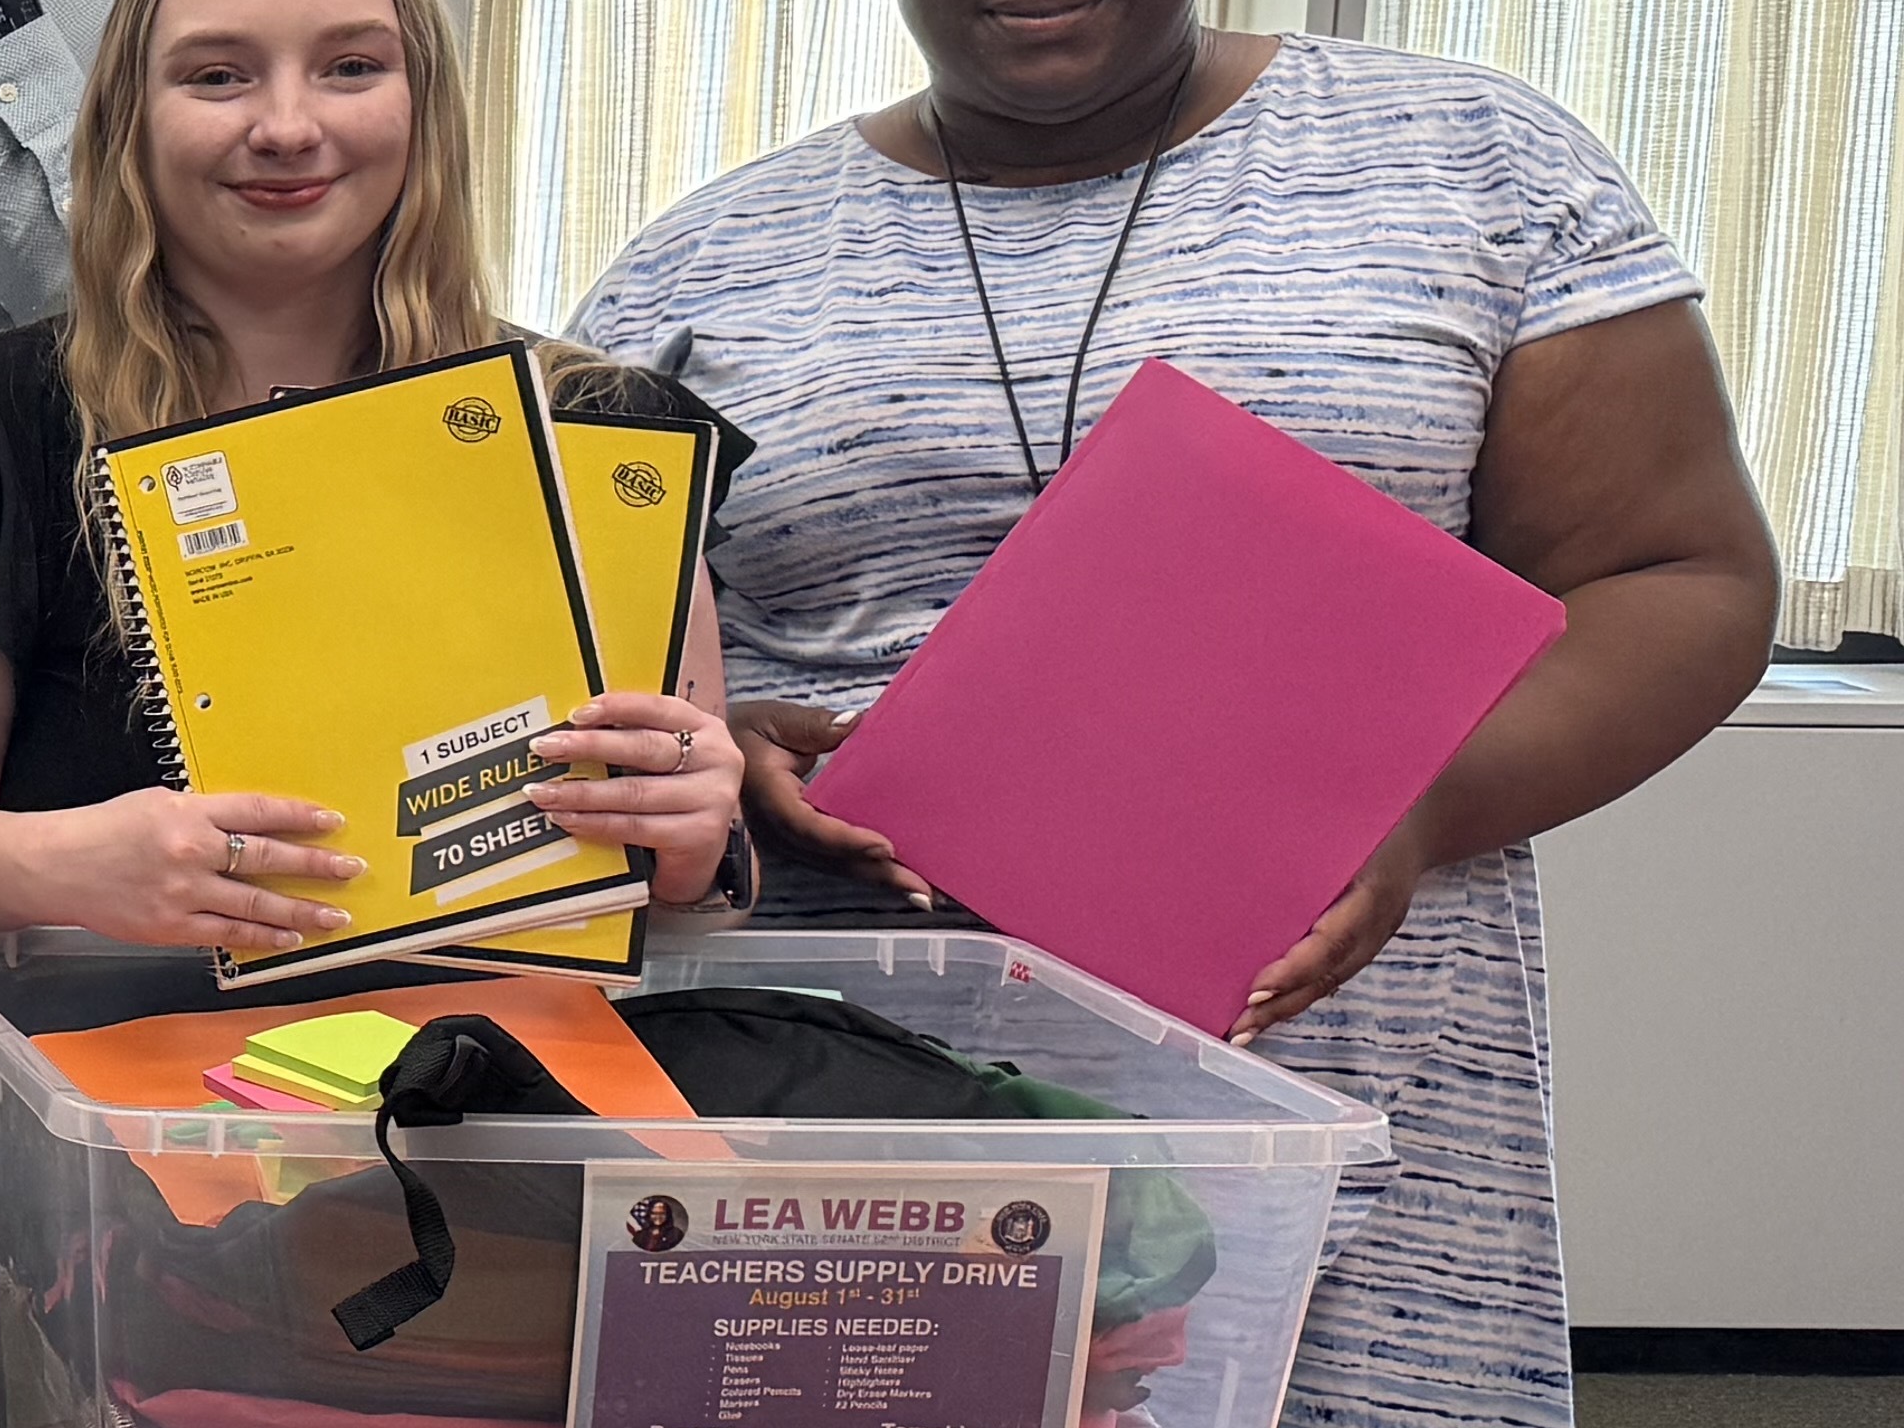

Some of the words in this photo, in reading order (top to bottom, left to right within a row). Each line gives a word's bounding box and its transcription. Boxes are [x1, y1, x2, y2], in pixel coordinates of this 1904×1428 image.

[419, 749, 431, 765] 1
[437, 712, 531, 760] SUBJECT
[406, 778, 475, 813] WIDE
[479, 753, 552, 797] RULE
[433, 841, 465, 871] 70
[470, 813, 556, 859] SHEET
[713, 1198, 805, 1231] LEA
[821, 1199, 966, 1233] WEBB
[640, 1261, 805, 1285] TEACHERS
[813, 1261, 935, 1285] SUPPLY
[942, 1263, 1039, 1288] DRIVE
[749, 1287, 829, 1310] August
[713, 1318, 828, 1338] SUPPLIES
[835, 1319, 939, 1337] NEEDED:
